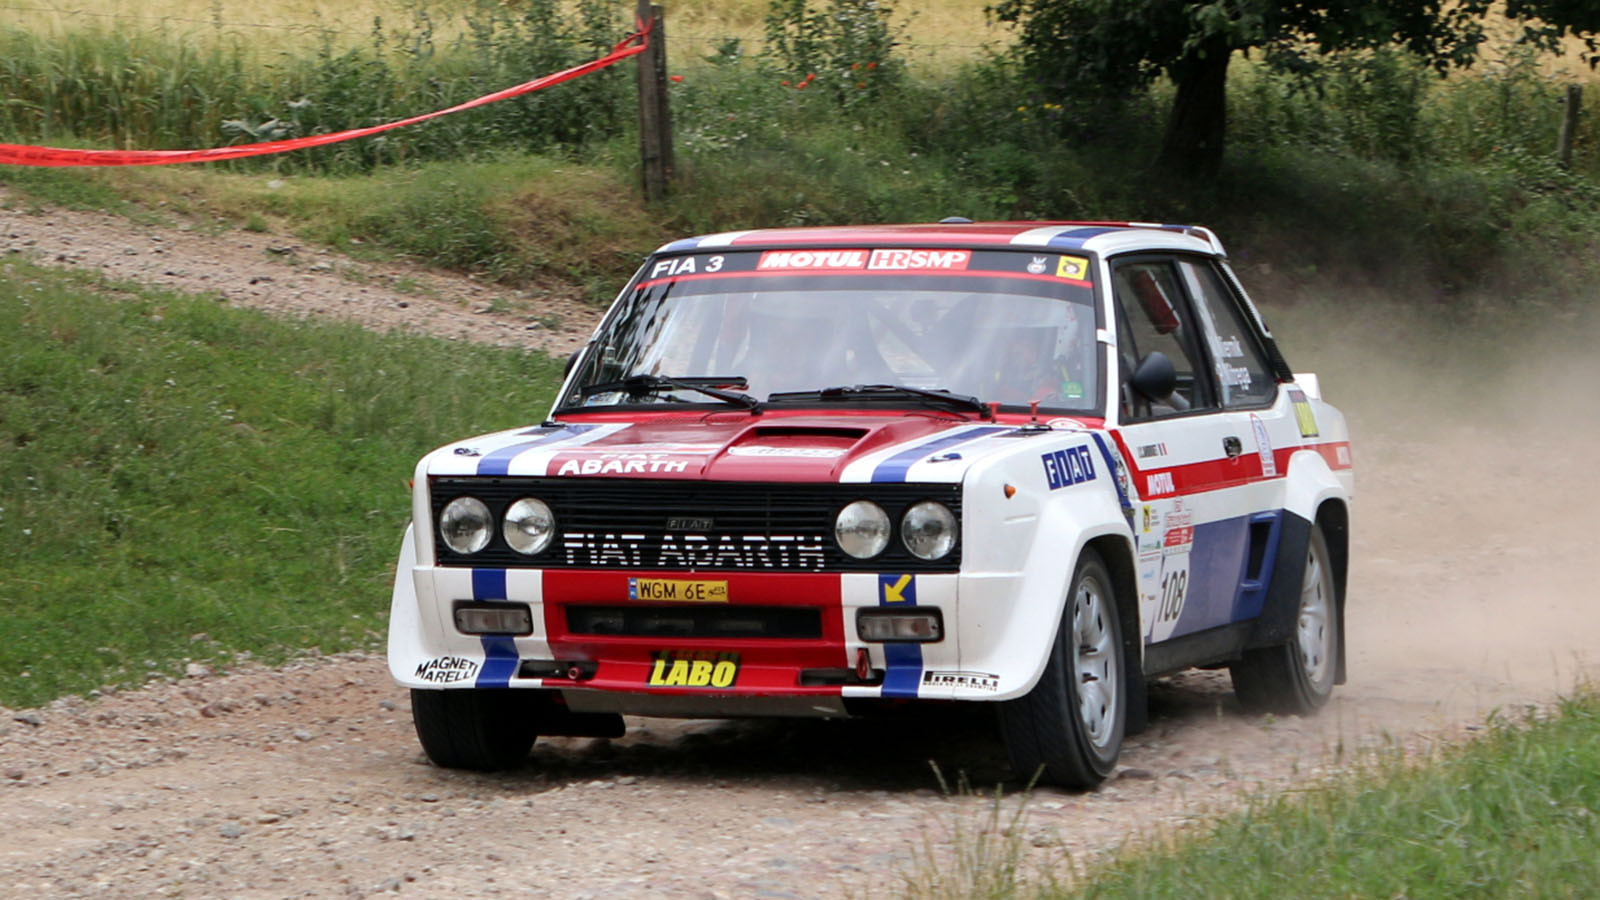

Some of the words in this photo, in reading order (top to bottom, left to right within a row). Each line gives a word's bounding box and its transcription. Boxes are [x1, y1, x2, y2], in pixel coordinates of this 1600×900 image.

[650, 257, 696, 278] FIA
[705, 256, 724, 272] 3
[761, 251, 865, 268] MOTUL
[558, 459, 688, 476] ABARTH
[1043, 447, 1095, 487] FIAT
[1147, 472, 1176, 496] MOTUL
[668, 518, 712, 530] FIAT
[563, 533, 646, 565] FIAT
[658, 535, 825, 568] ABARTH
[640, 582, 677, 599] WGM
[684, 583, 705, 600] 6E
[1158, 569, 1186, 622] 108
[415, 656, 478, 676] MAGNETI
[649, 659, 736, 687] LABO
[924, 671, 1000, 688] PIRELLI
